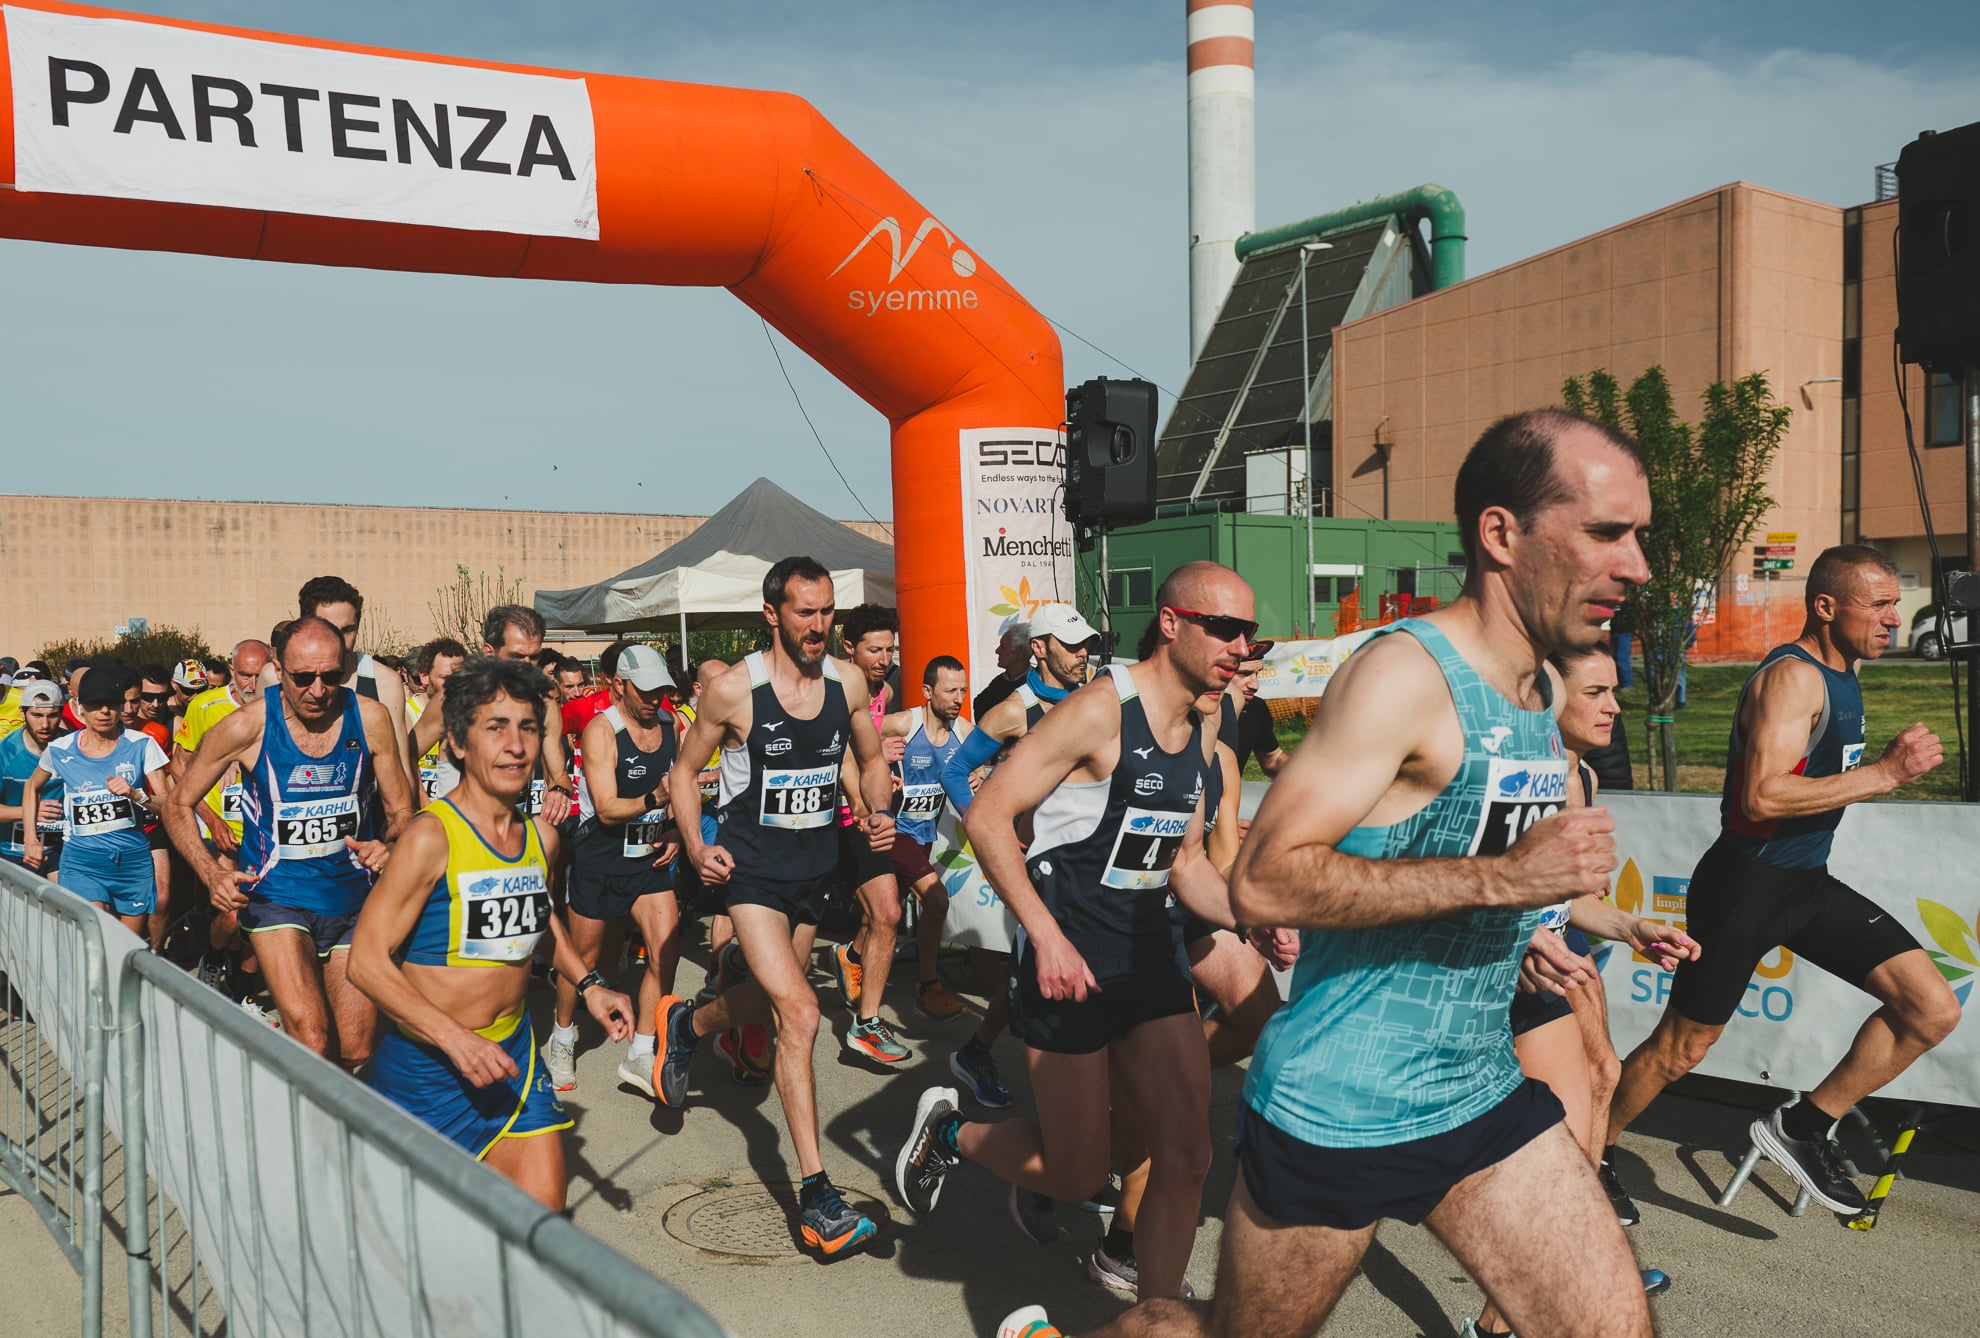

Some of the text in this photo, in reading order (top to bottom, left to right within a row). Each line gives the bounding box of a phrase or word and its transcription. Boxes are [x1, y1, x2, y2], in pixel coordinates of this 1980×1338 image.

[48, 56, 577, 182] PARTENZA
[847, 289, 979, 318] syemme
[981, 474, 1014, 483] Endless
[1016, 475, 1037, 484] ways
[977, 497, 1057, 515] NOVART
[982, 535, 1072, 558] Menchetti
[1021, 560, 1054, 568] DAL 194
[1257, 667, 1277, 679] ERO
[1307, 664, 1334, 676] ZERO
[765, 742, 792, 752] SECO
[793, 770, 835, 787] KARHU
[1135, 778, 1164, 790] SECO
[1529, 773, 1566, 798] KARH
[305, 800, 355, 818] KARHU
[775, 787, 821, 814] 188
[908, 795, 935, 812] 221
[78, 803, 116, 825] 333
[648, 813, 666, 823] KAR
[287, 817, 339, 845] 265
[1142, 837, 1162, 870] 4
[502, 875, 545, 894] KARHU
[480, 895, 537, 939] 324
[1631, 968, 1794, 1022] SPCO
